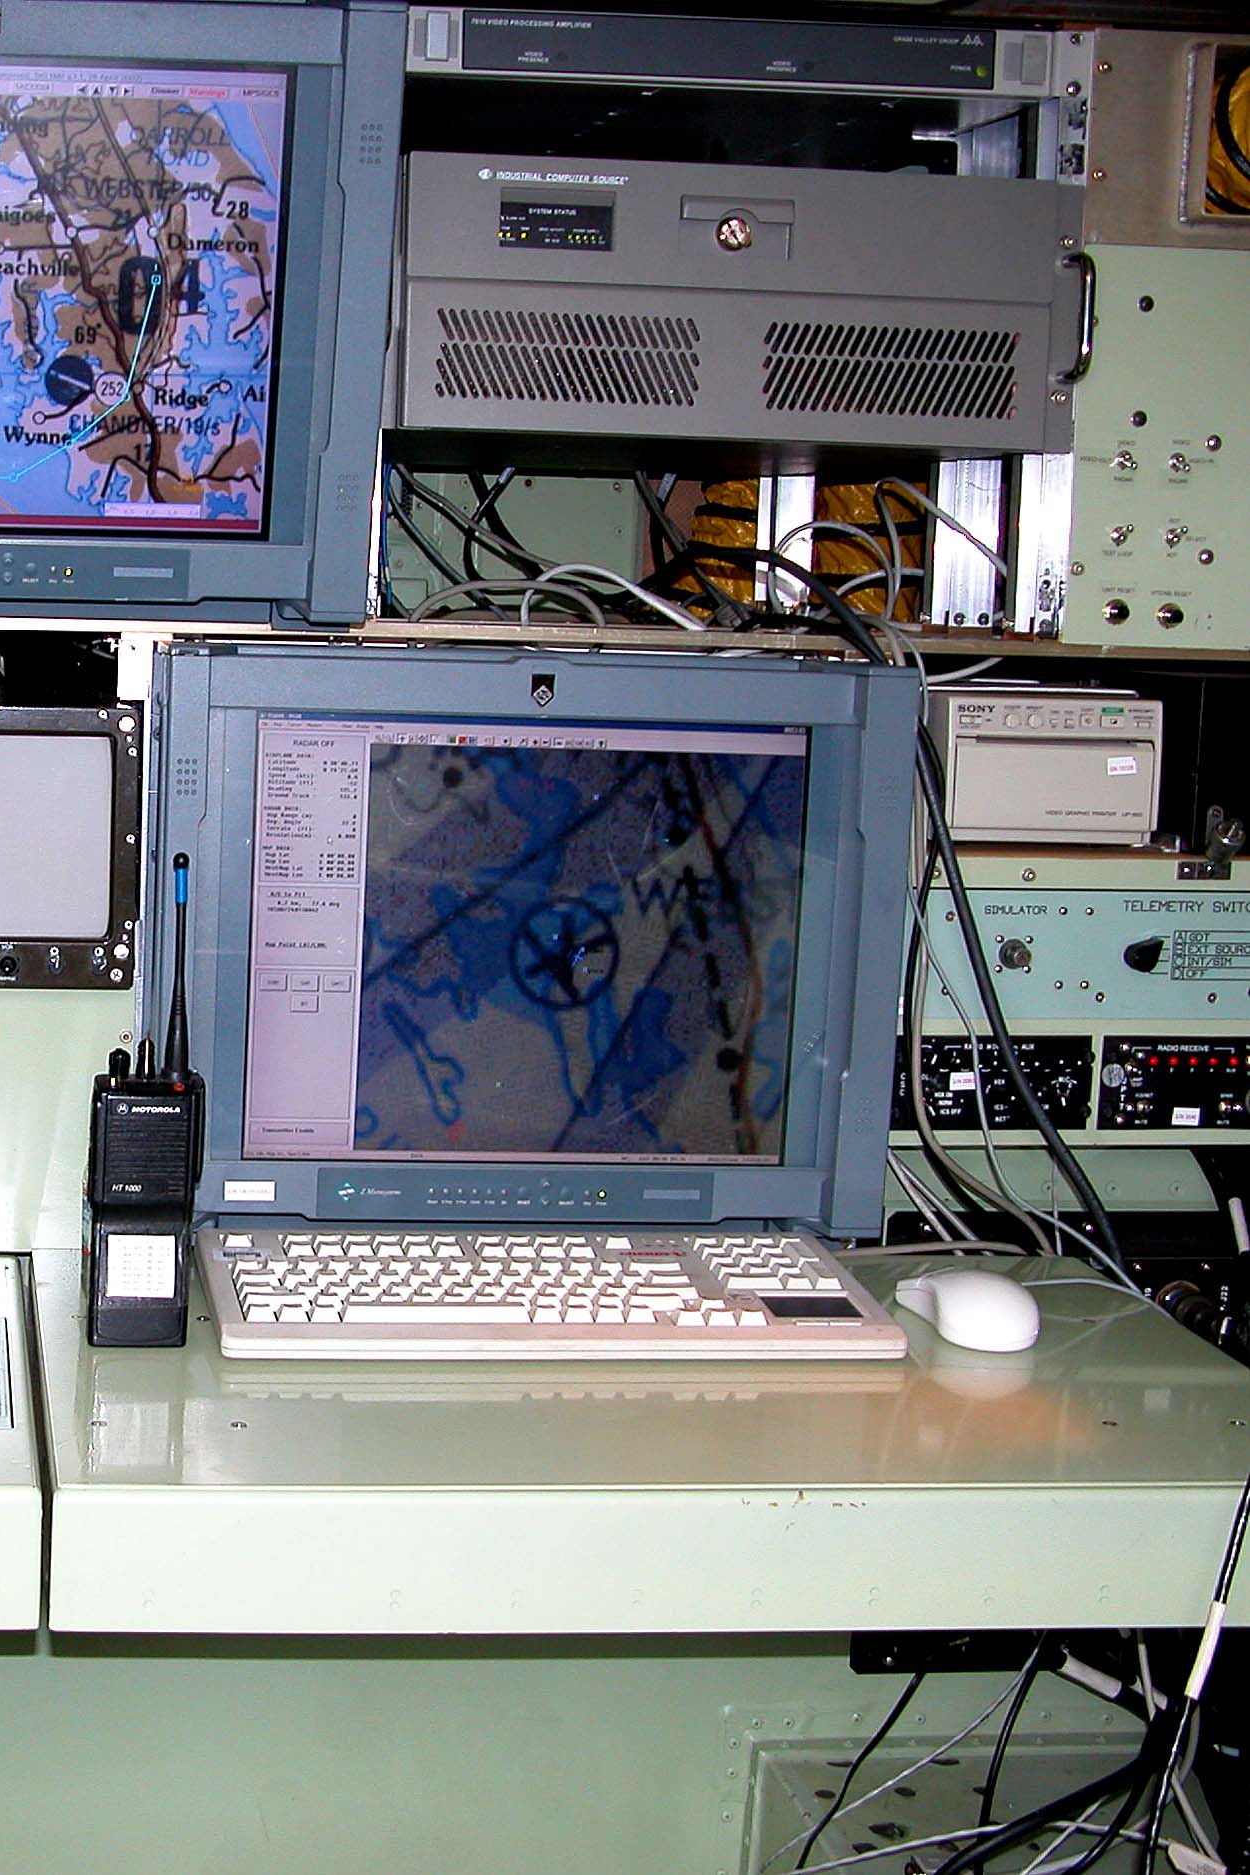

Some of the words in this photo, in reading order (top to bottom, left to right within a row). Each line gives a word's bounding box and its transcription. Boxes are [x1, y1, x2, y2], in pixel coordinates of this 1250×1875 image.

[495, 171, 543, 181] INDUSTRIAL
[545, 173, 590, 183] COMPUTER
[74, 325, 97, 345] 69
[100, 380, 124, 397] 252
[153, 388, 209, 408] Ridge
[4, 425, 72, 445] Wynne
[957, 704, 996, 713] SONY
[293, 739, 320, 748] RADAR
[321, 739, 335, 748] OFF
[983, 904, 1048, 916] SIMULATOR
[1123, 899, 1205, 913] TELEMETRY
[1188, 945, 1209, 953] EXT
[1188, 957, 1232, 966] INT/SIM
[1186, 968, 1208, 978] OFF
[1156, 1044, 1179, 1052] RADIO
[1179, 1044, 1210, 1052] RECEIVE
[131, 1105, 181, 1114] MOTOROLA
[112, 1184, 123, 1193] HT
[124, 1184, 142, 1193] 1000
